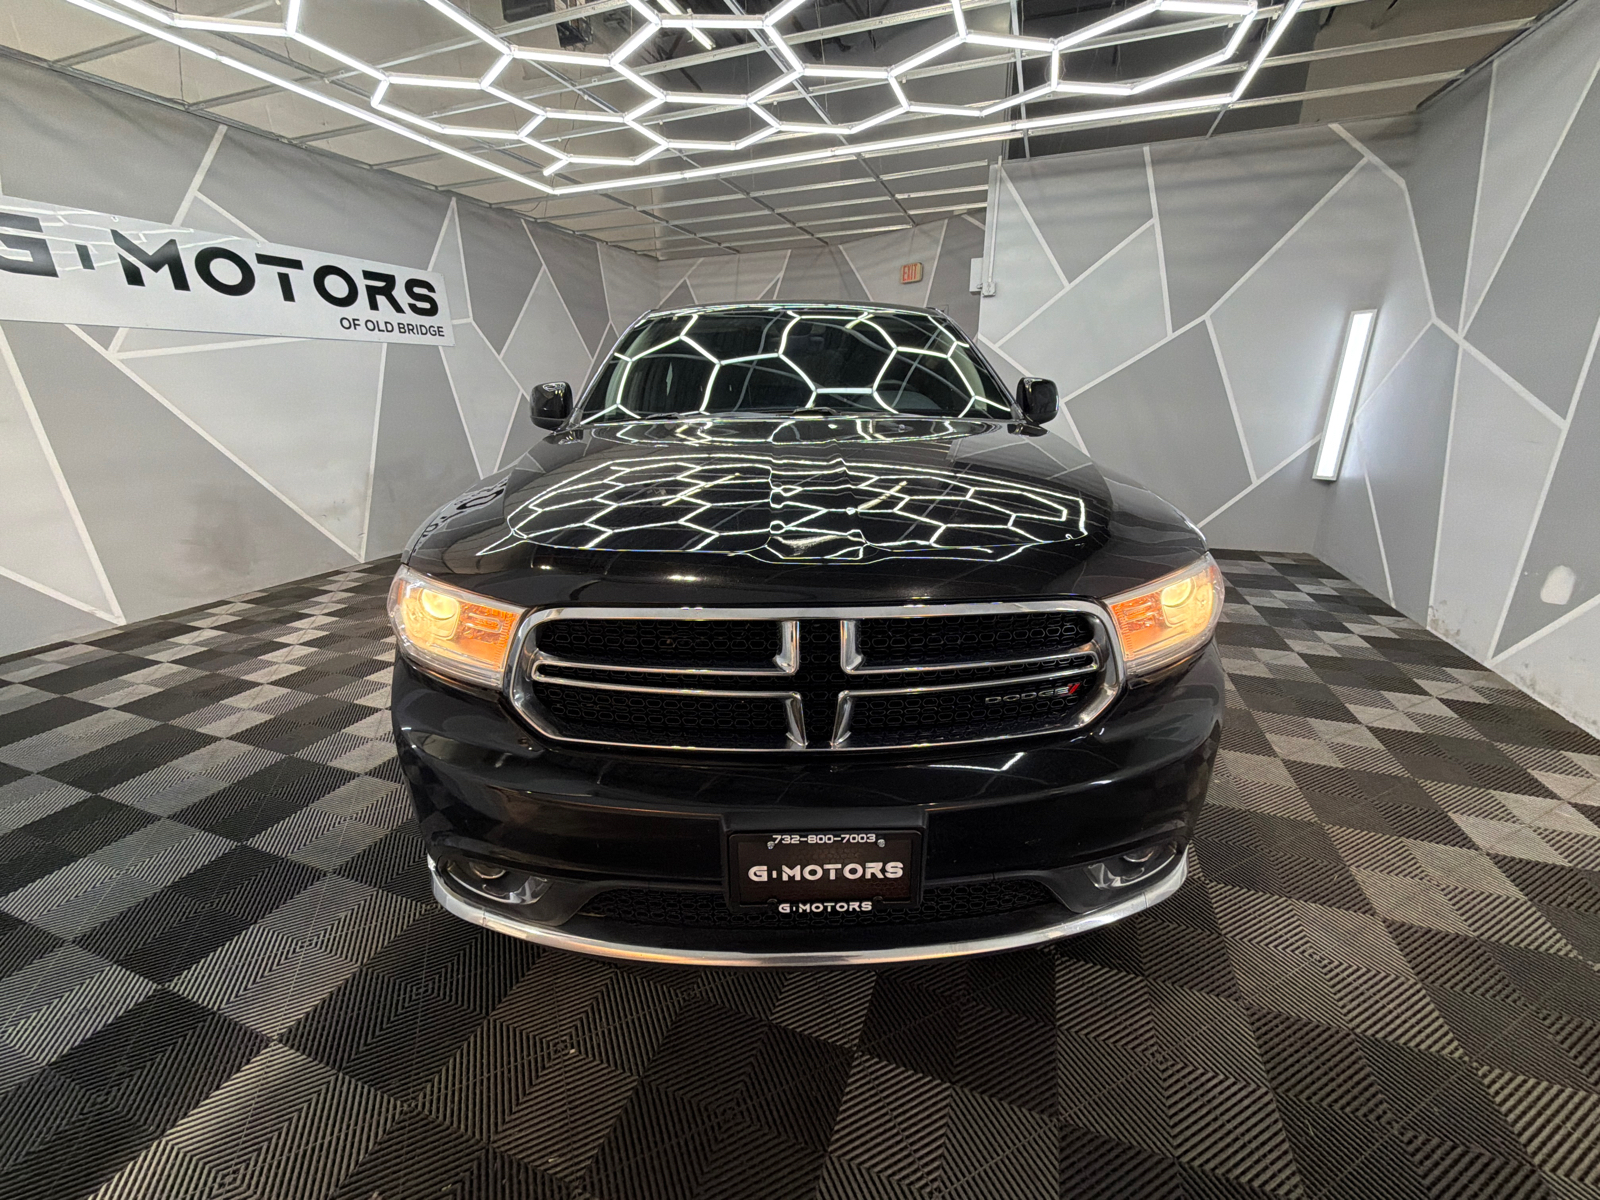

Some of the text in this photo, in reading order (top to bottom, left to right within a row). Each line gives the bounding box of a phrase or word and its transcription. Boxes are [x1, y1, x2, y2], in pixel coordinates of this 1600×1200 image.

[902, 263, 918, 281] EXIT
[340, 317, 445, 337] OF OLD BRIDGE
[985, 687, 1069, 703] DODGE
[772, 834, 876, 844] 732-800-7003
